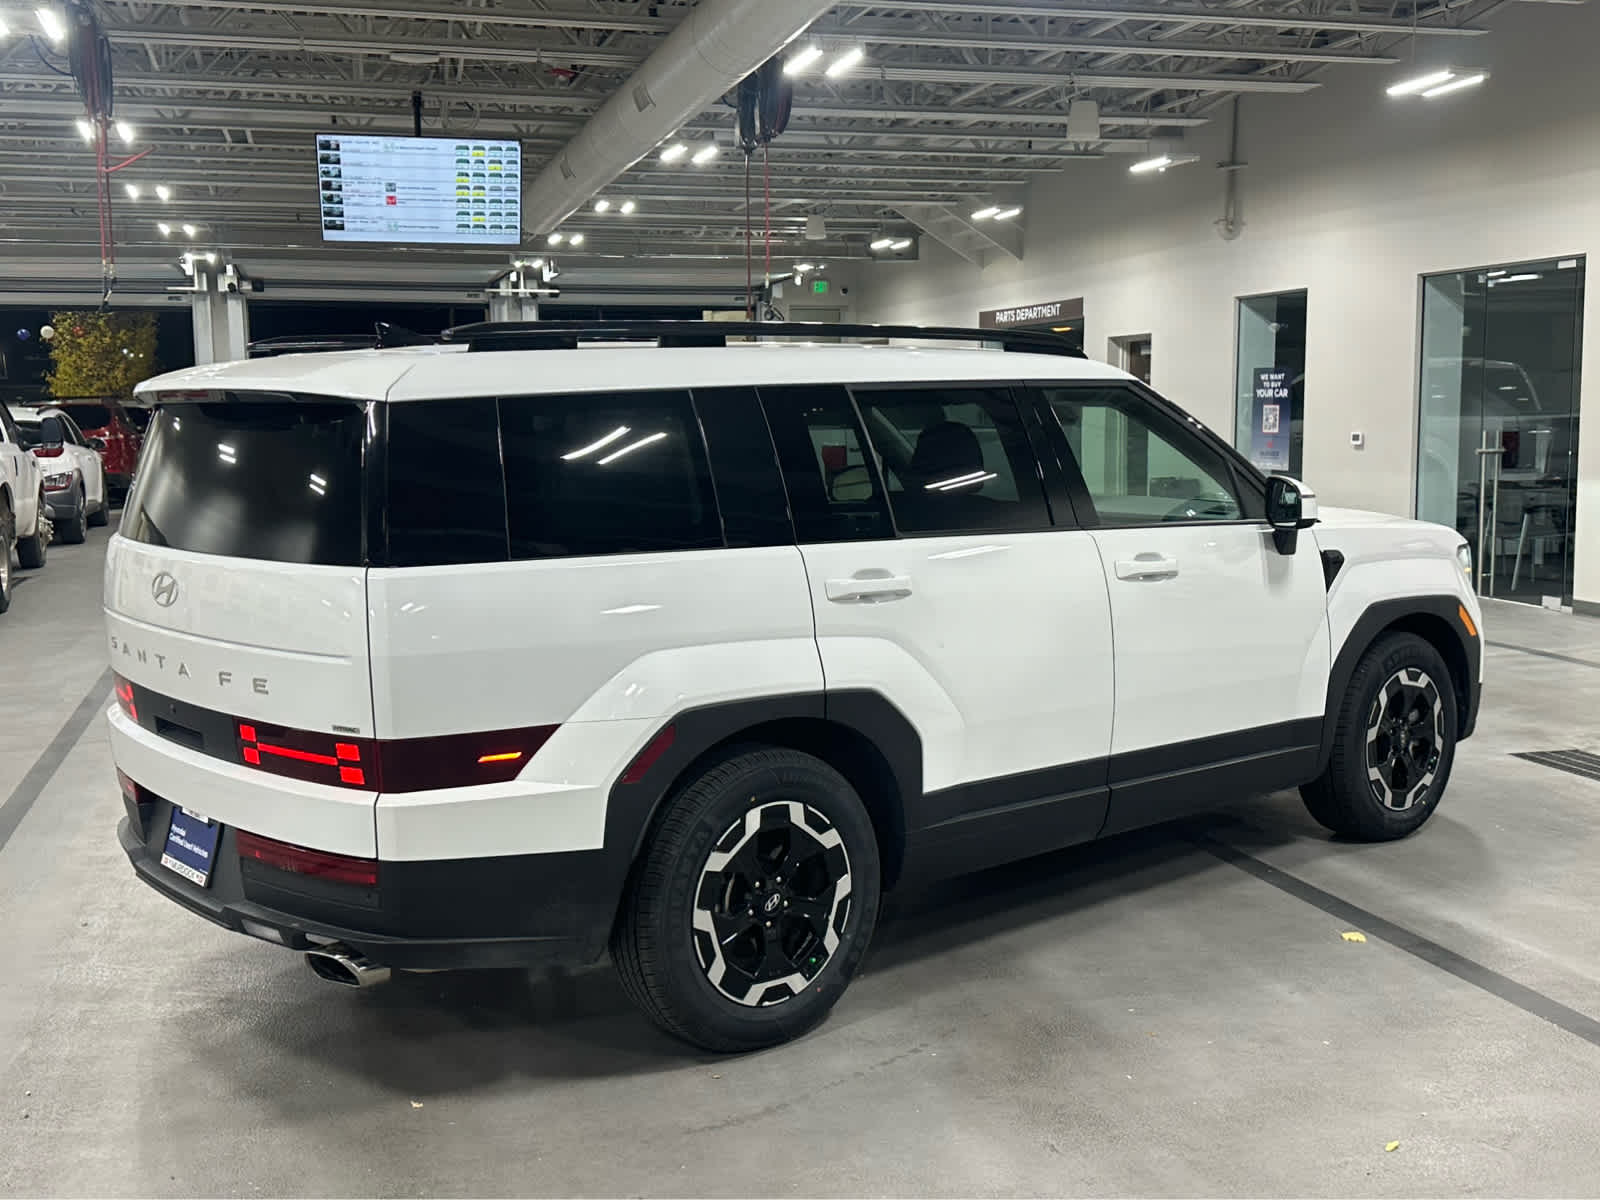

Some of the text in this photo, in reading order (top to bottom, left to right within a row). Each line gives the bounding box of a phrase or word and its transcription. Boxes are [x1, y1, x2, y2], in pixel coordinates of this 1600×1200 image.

[995, 304, 1061, 323] PARTS DEPARTMENT
[1269, 373, 1285, 381] WANT
[1256, 389, 1288, 398] YOUR CAR
[111, 636, 270, 696] SANTA FE
